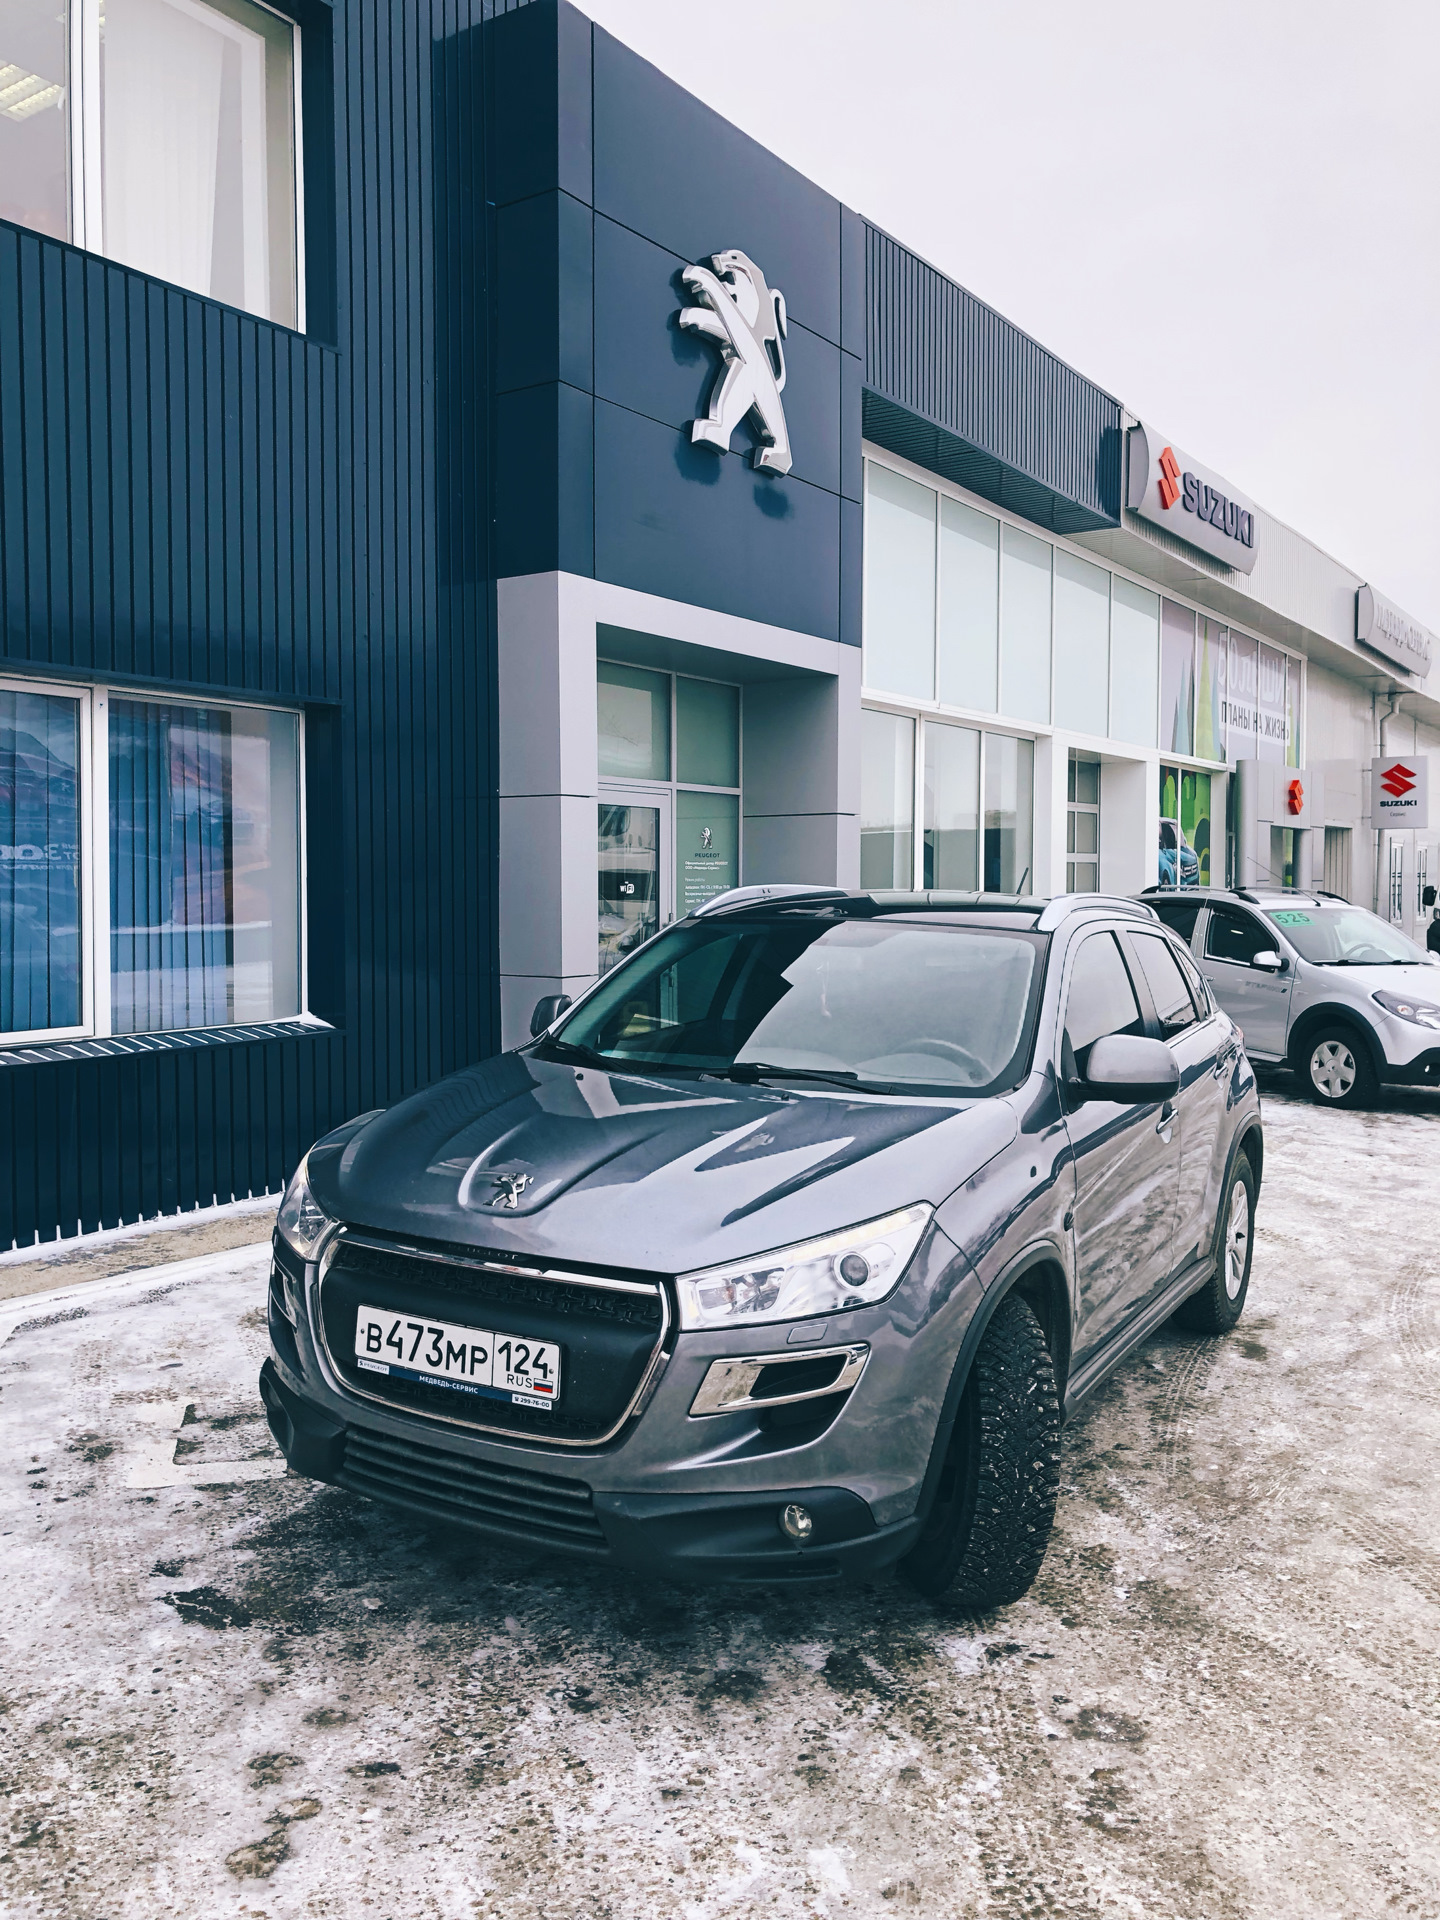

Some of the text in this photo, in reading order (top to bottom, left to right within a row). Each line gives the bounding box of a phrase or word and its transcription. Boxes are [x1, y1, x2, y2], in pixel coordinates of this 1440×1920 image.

[1182, 471, 1254, 549] SUZUKI
[1275, 912, 1310, 924] 525
[366, 1319, 549, 1379] В473МР 124
[419, 1375, 479, 1394] МЕДВЕДЬ-СЕРВИС
[506, 1373, 533, 1389] RUS
[520, 1397, 550, 1408] 299-76-00
